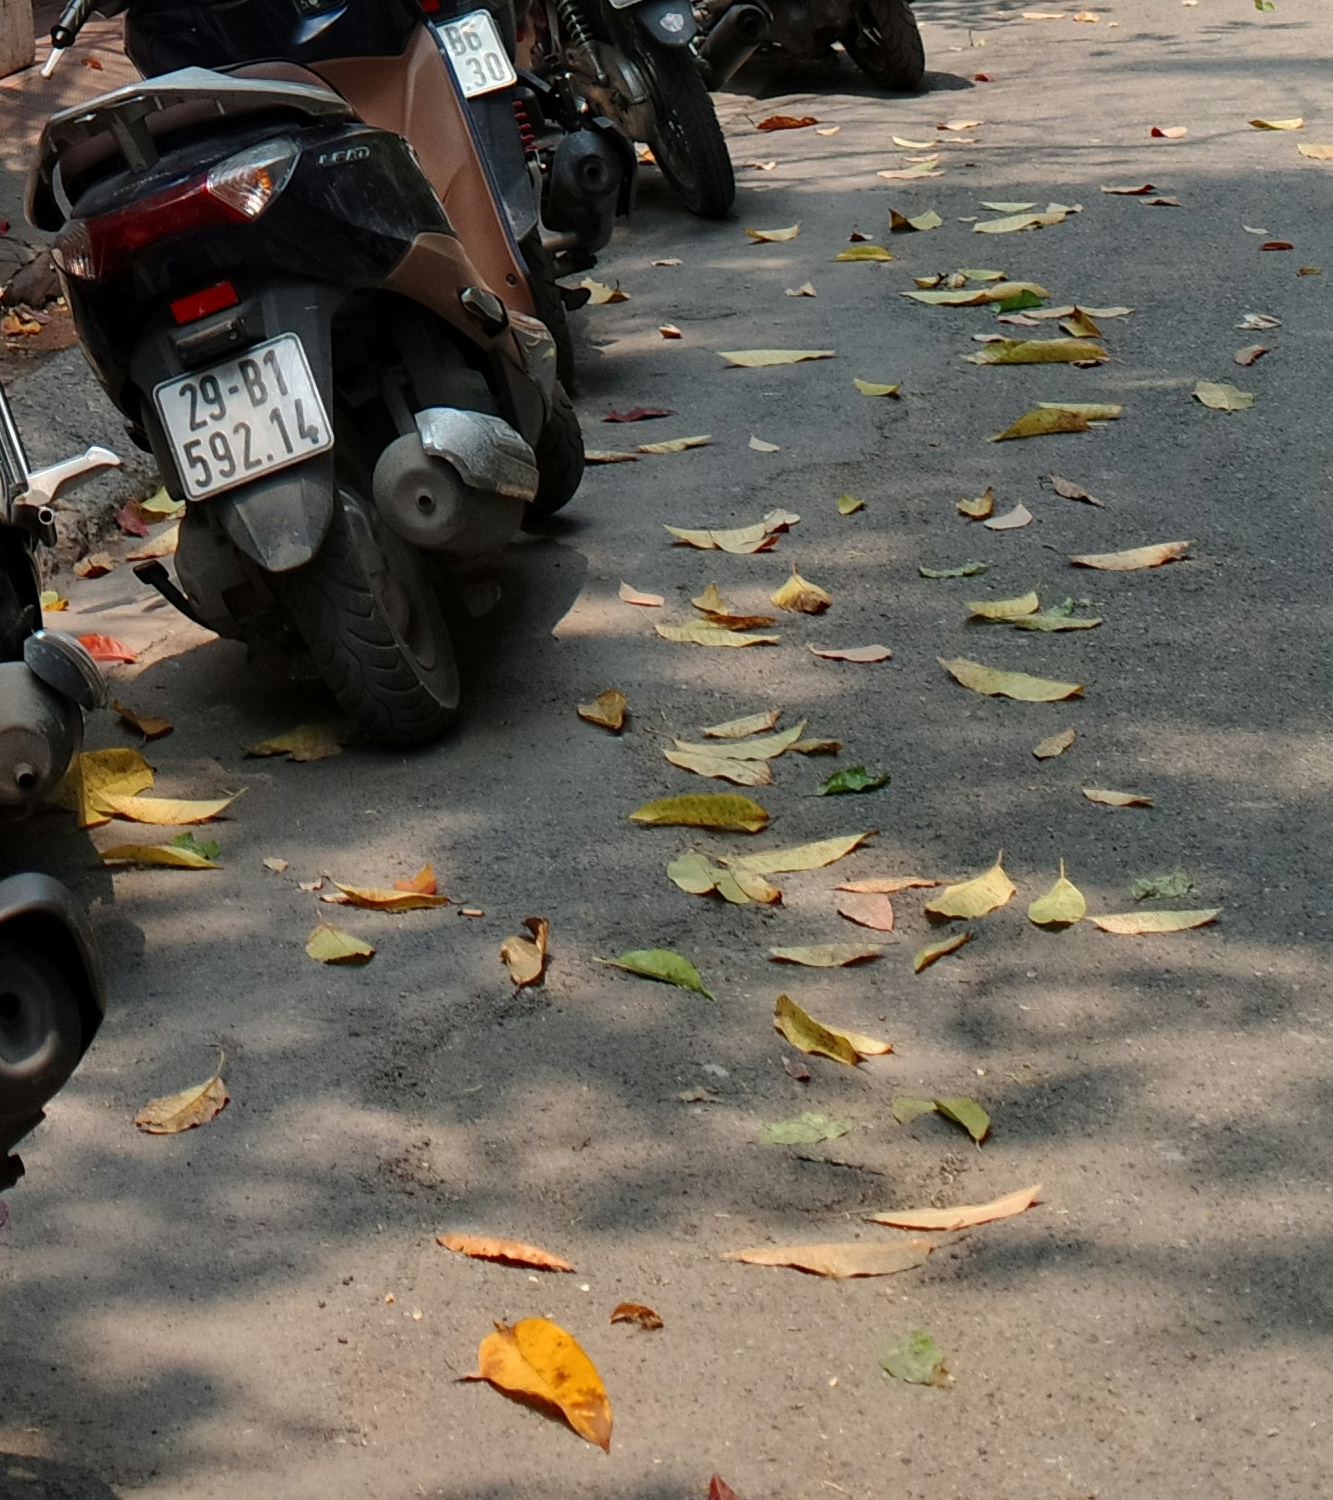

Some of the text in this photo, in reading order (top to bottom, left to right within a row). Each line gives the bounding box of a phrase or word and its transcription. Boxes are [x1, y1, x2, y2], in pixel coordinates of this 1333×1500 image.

[318, 146, 371, 168] LEAD
[179, 348, 290, 433] 29-B1
[182, 398, 320, 488] 592.14
